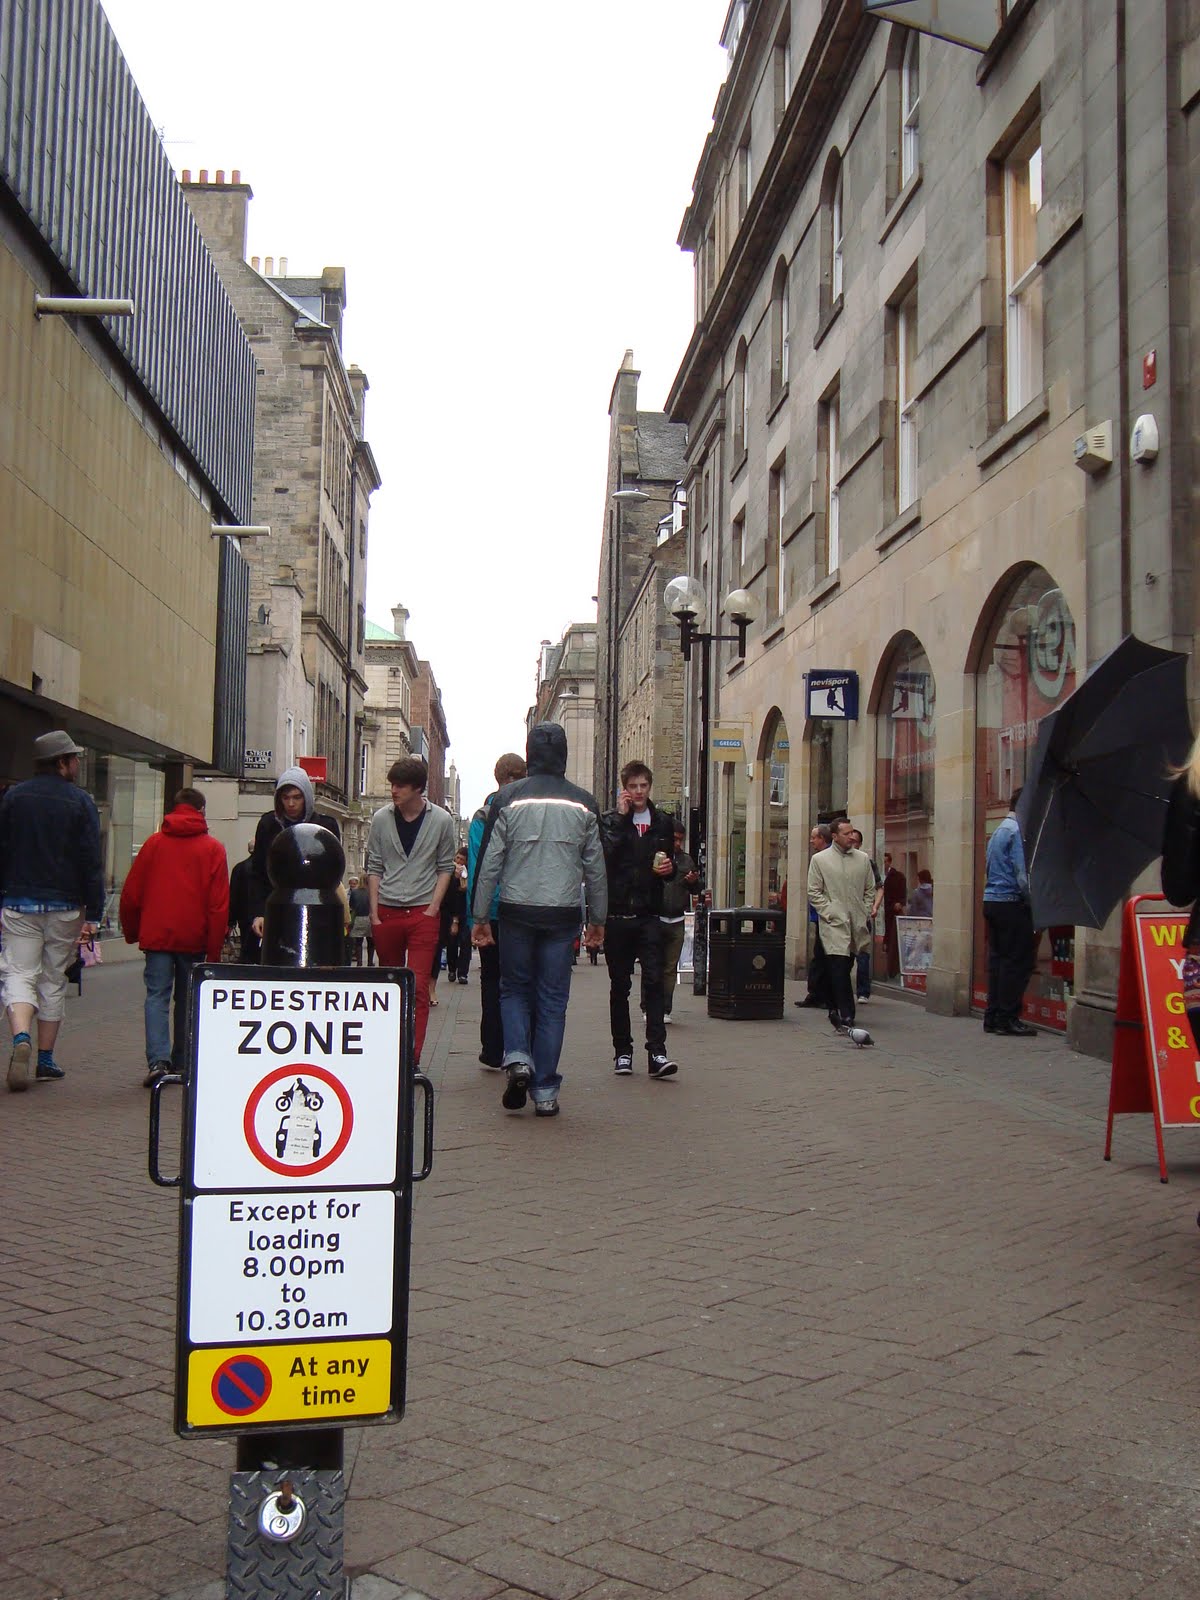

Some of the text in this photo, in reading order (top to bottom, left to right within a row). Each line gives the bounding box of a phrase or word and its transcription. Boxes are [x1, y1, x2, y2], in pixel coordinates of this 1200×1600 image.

[810, 677, 850, 688] nevisport
[719, 740, 741, 748] GREGGS
[212, 989, 390, 1012] PEDESTRIAN
[237, 1020, 364, 1055] ZONE
[229, 1198, 361, 1223] Except for
[248, 1229, 340, 1252] loading
[243, 1255, 345, 1279] 8.00pm
[281, 1283, 306, 1303] to
[235, 1308, 348, 1332] 10.30am
[289, 1356, 370, 1378] At any
[301, 1385, 356, 1406] time
